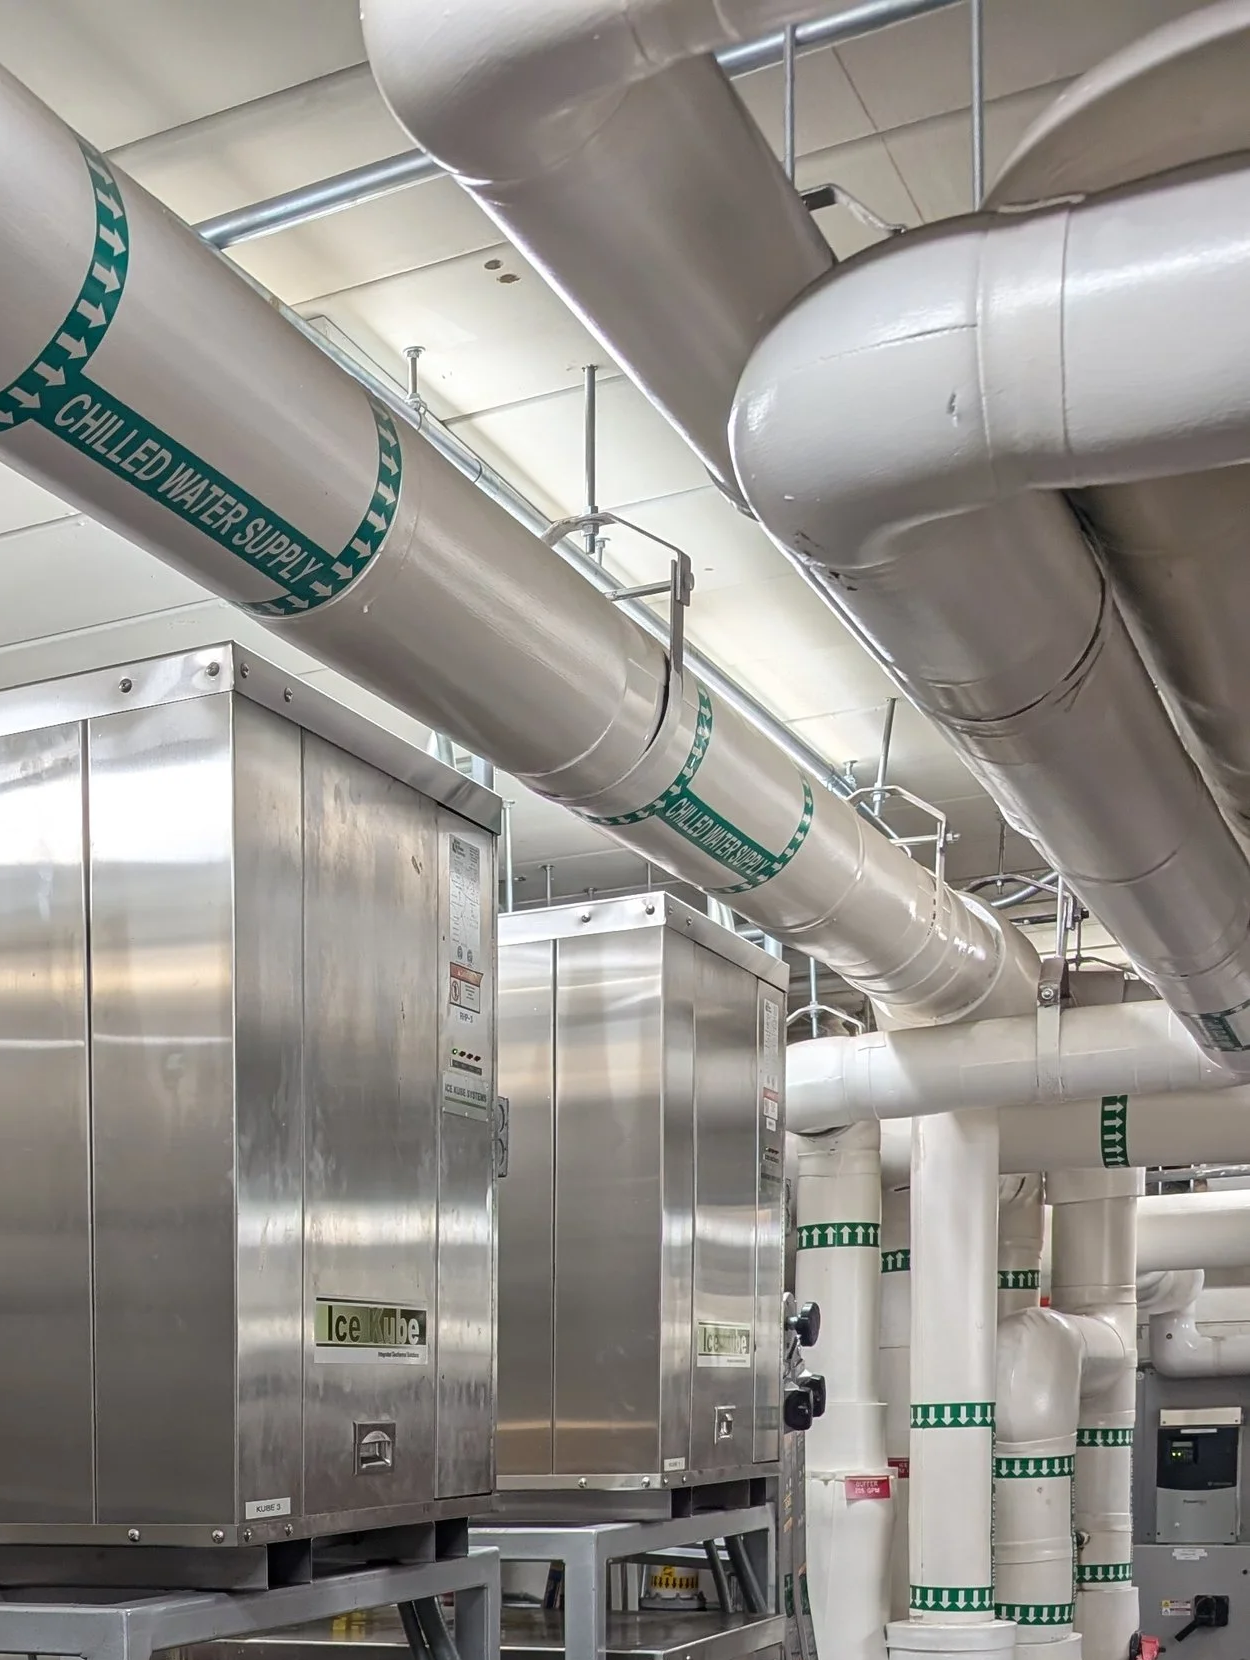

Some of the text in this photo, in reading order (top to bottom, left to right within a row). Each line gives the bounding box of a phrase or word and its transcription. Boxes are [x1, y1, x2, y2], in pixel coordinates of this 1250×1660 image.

[53, 393, 326, 583] CHILLED WATER SUPPLY
[665, 797, 771, 876] CHILLED WATER SUPPLY
[453, 1087, 466, 1098] KUBE
[467, 1089, 487, 1102] SYSTEMS
[327, 1304, 420, 1346] Ice Kube
[703, 1327, 719, 1353] Ice
[256, 1503, 281, 1513] KUBE 3
